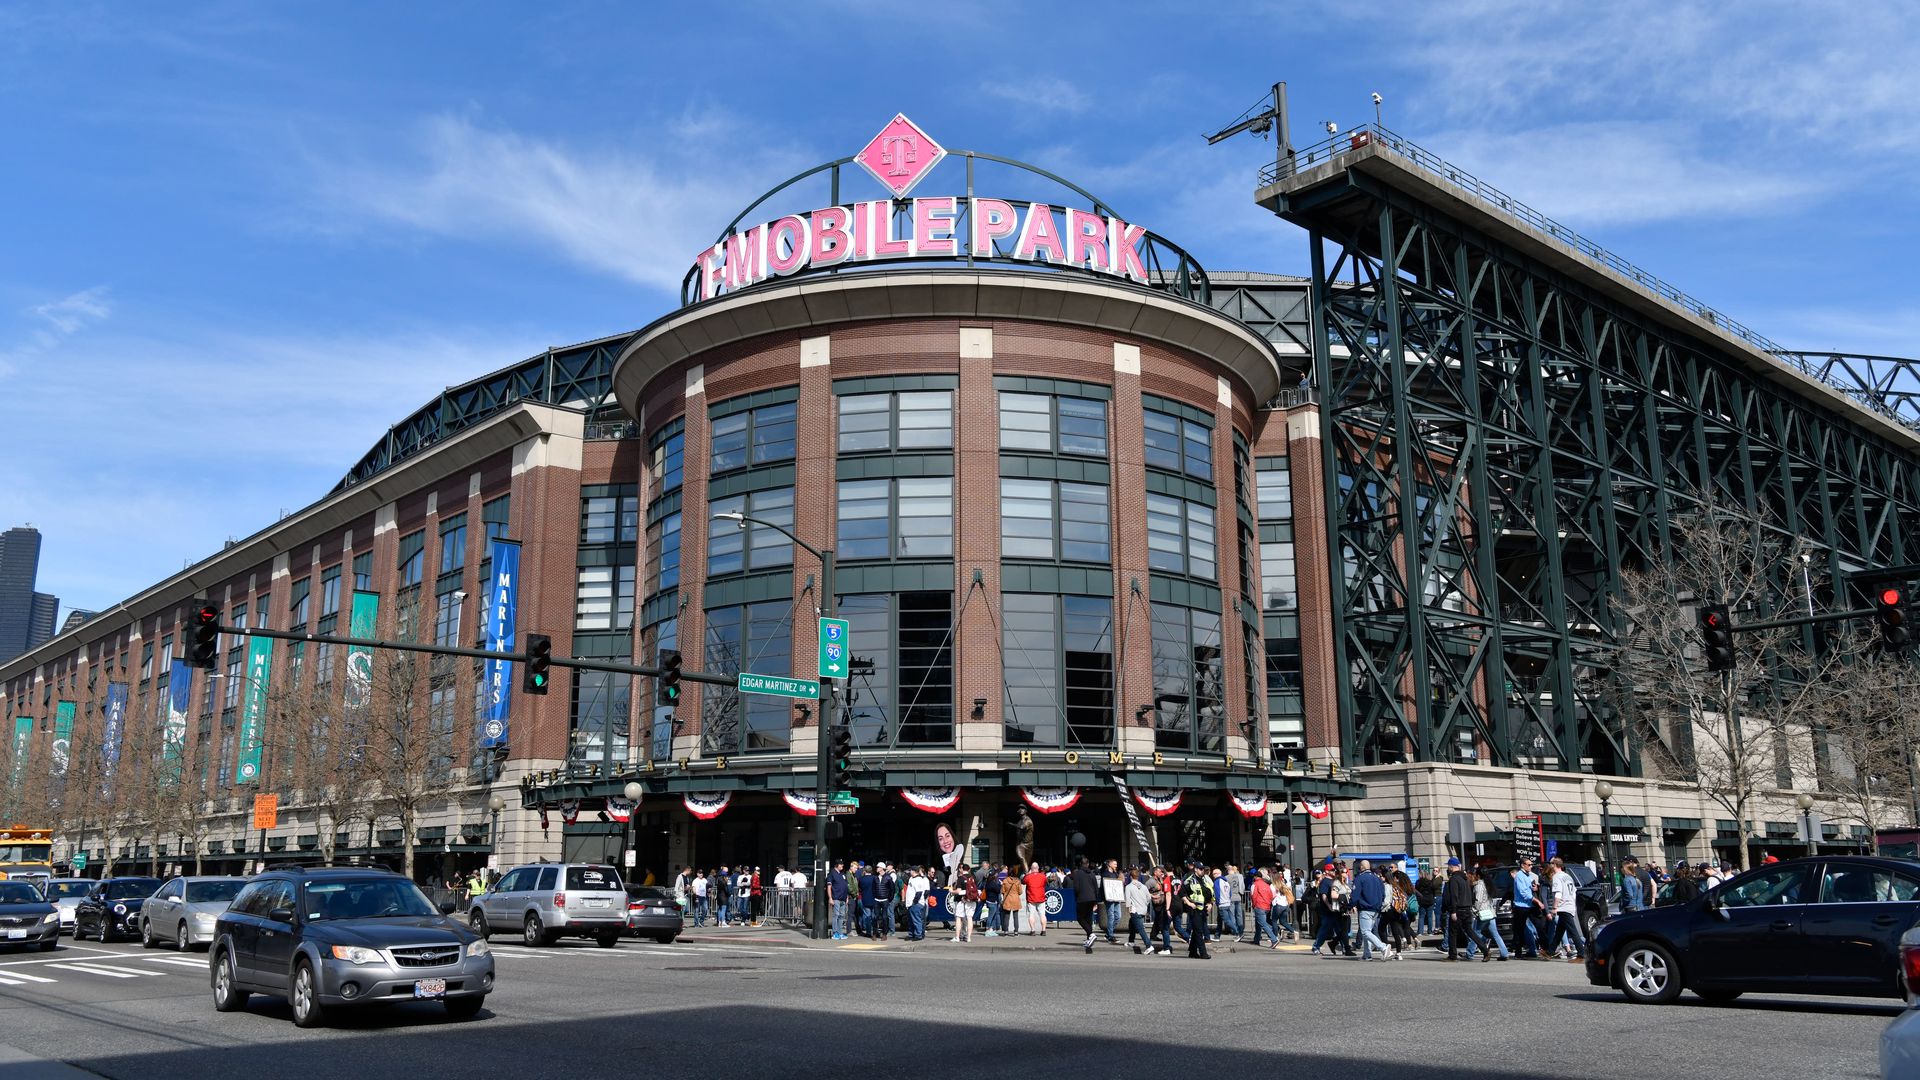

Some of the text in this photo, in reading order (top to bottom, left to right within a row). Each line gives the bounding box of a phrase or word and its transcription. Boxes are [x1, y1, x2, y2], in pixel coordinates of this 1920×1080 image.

[882, 135, 917, 177] T
[697, 197, 1150, 302] T-MOBILE PARK
[493, 573, 510, 704] MARINERS
[830, 628, 837, 639] 5
[827, 648, 840, 657] 90
[742, 677, 807, 692] EDGAR MARTINEZ DR
[248, 654, 265, 752] MARINERS
[590, 756, 727, 775] PLATE
[1020, 751, 1163, 765] HOME
